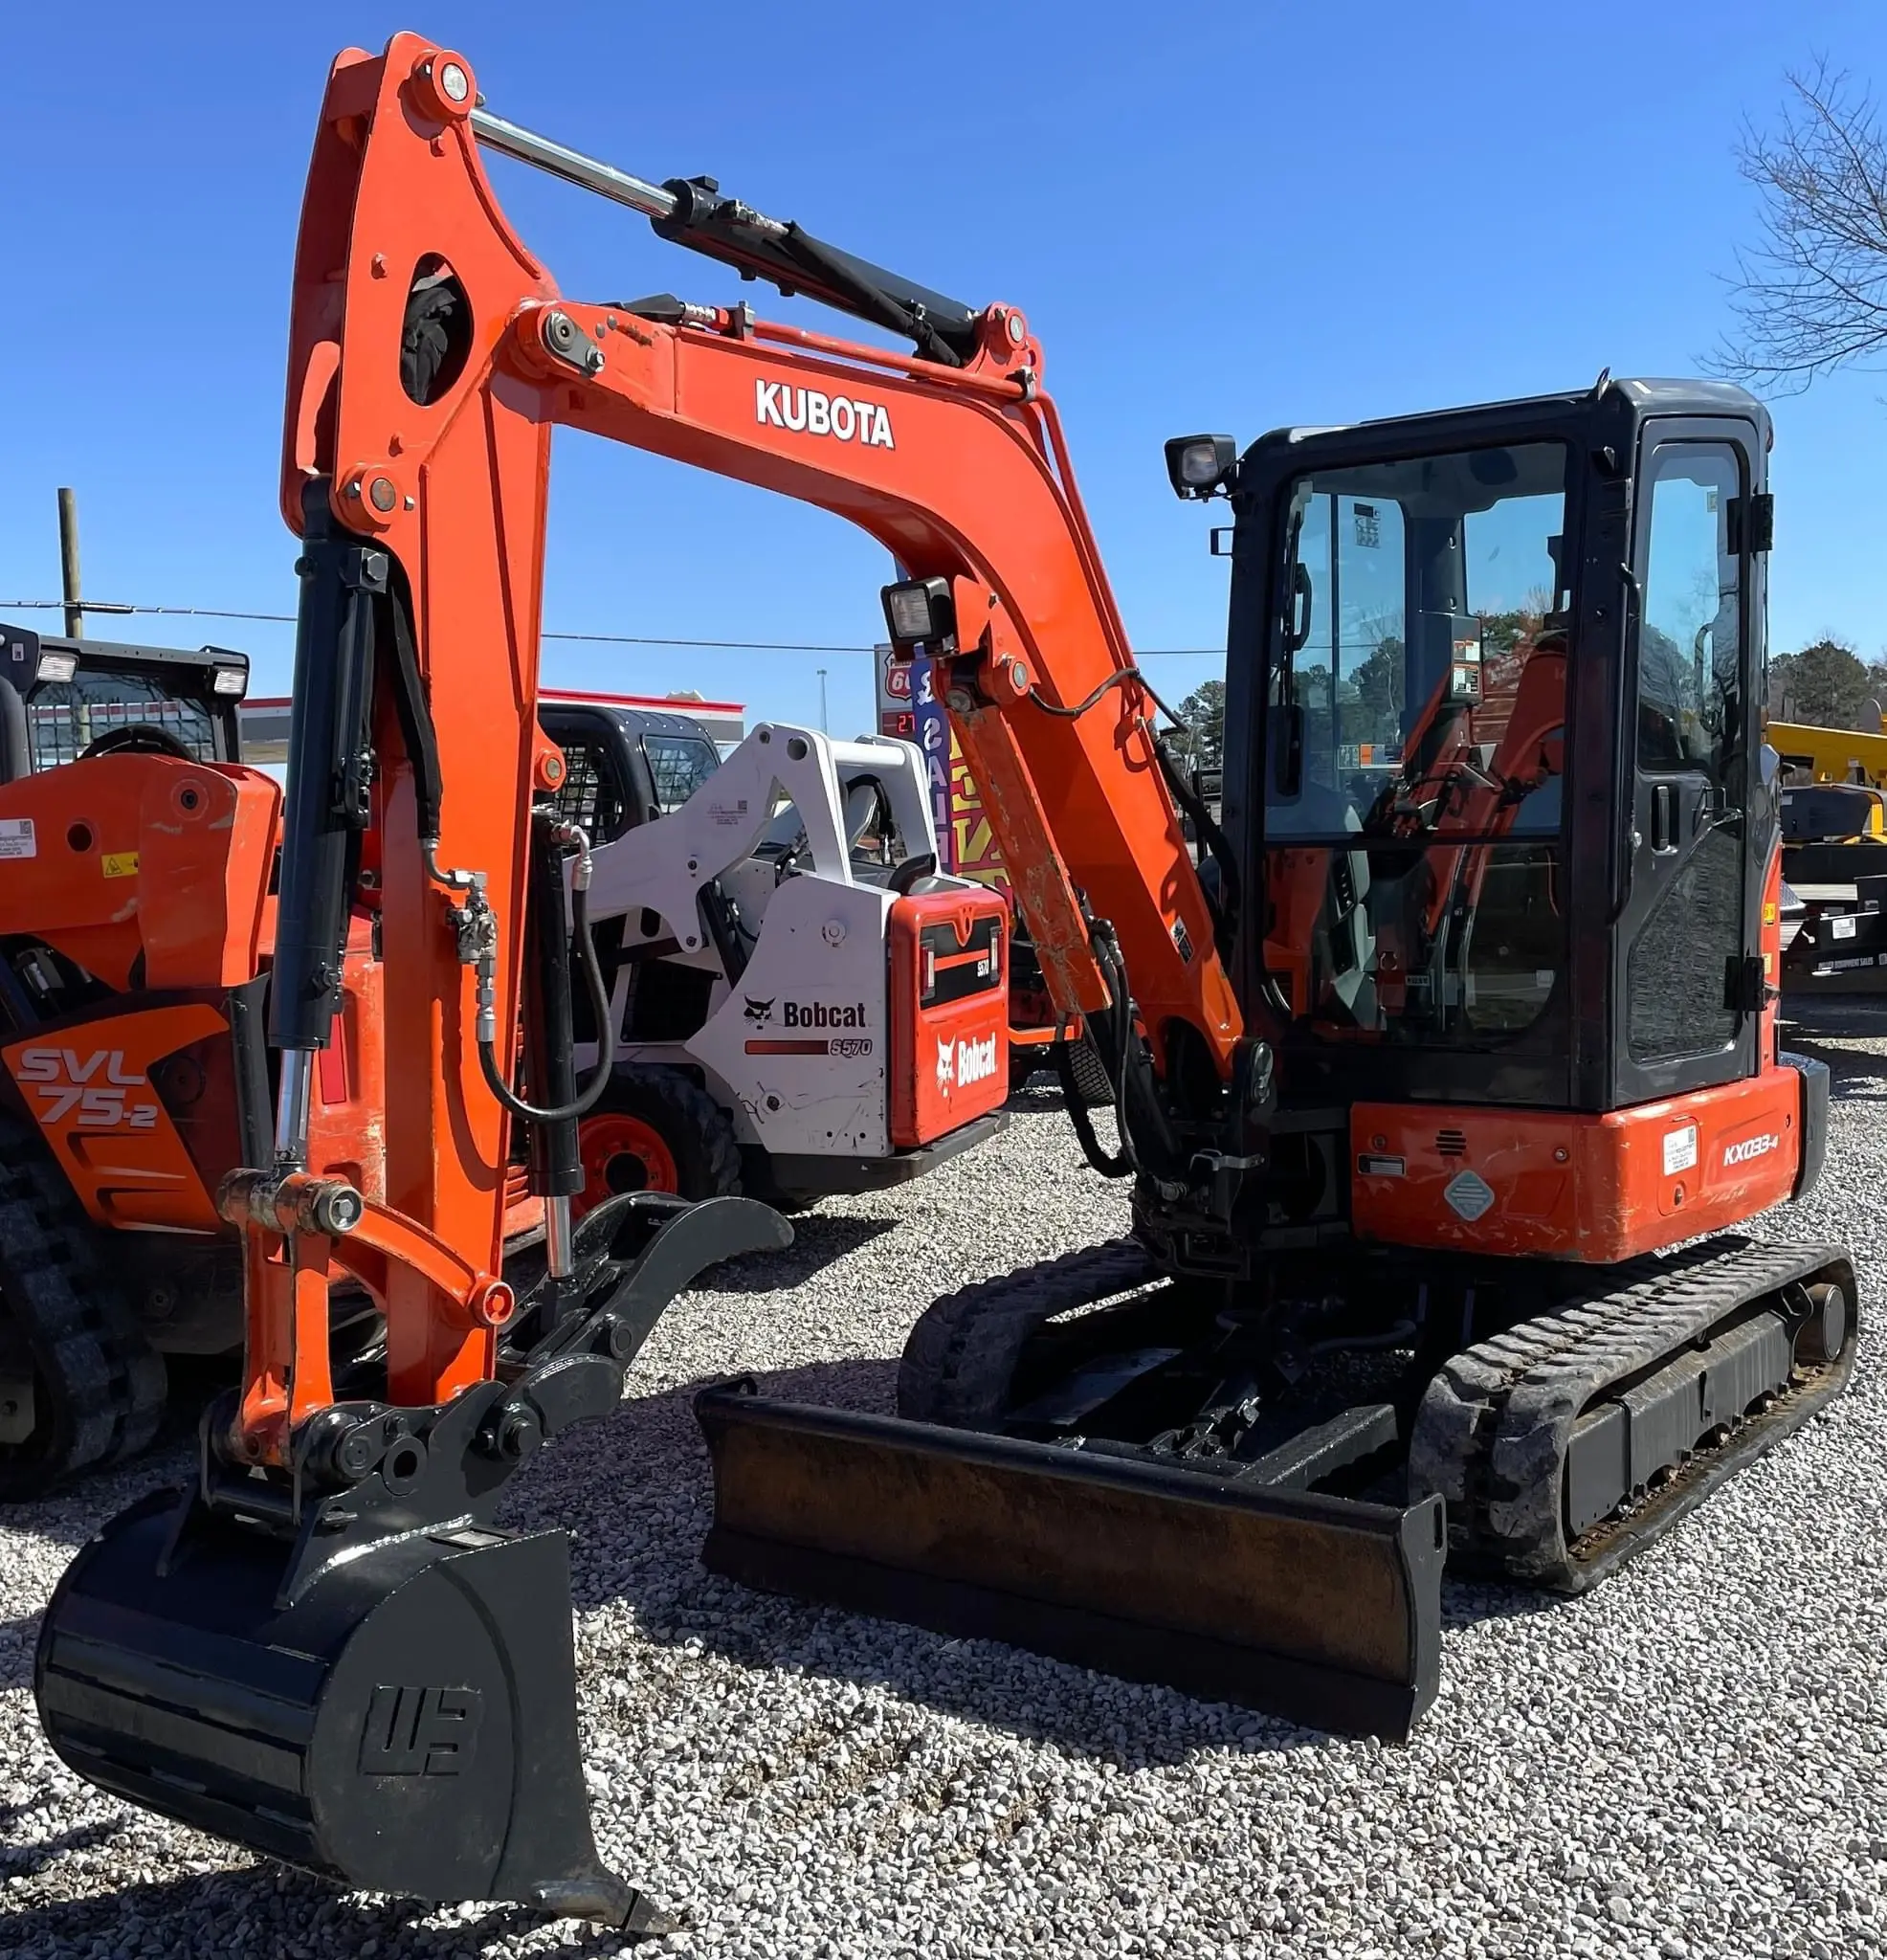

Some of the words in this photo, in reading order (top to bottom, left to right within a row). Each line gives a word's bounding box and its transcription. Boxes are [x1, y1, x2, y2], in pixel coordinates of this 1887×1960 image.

[754, 378, 896, 450] KUBOTA
[784, 1002, 866, 1028] Bobcat
[17, 1048, 146, 1085] SVL
[829, 1038, 873, 1058] S570
[958, 1032, 997, 1088] Bobcat
[38, 1086, 158, 1128] 75-2
[1722, 1133, 1780, 1167] KX033-4
